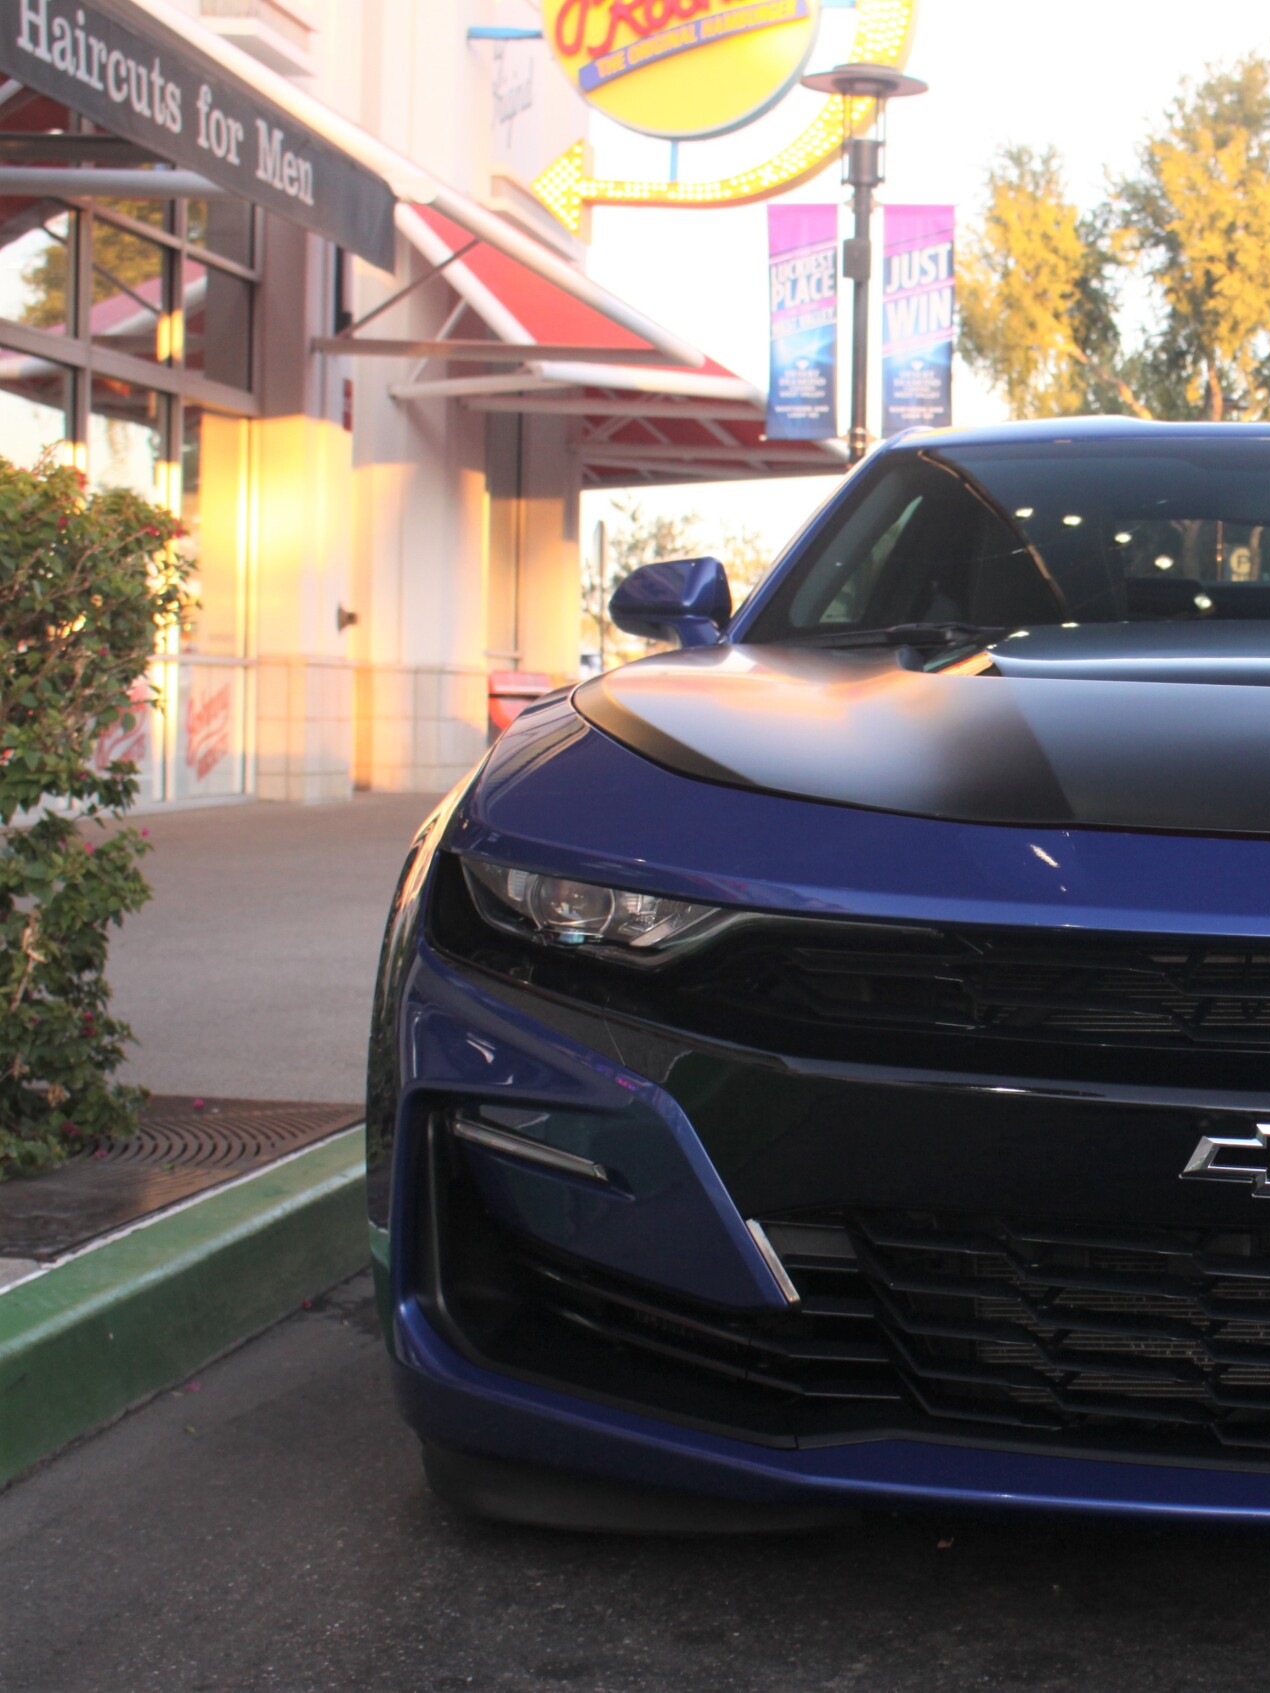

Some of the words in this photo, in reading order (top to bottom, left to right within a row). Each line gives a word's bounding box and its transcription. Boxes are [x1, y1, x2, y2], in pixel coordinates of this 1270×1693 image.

[17, 0, 182, 133] Haircuts
[197, 84, 244, 165] for
[255, 118, 315, 206] Men
[772, 273, 836, 313] PLACE
[885, 242, 952, 293] JUST
[885, 287, 952, 343] WIN
